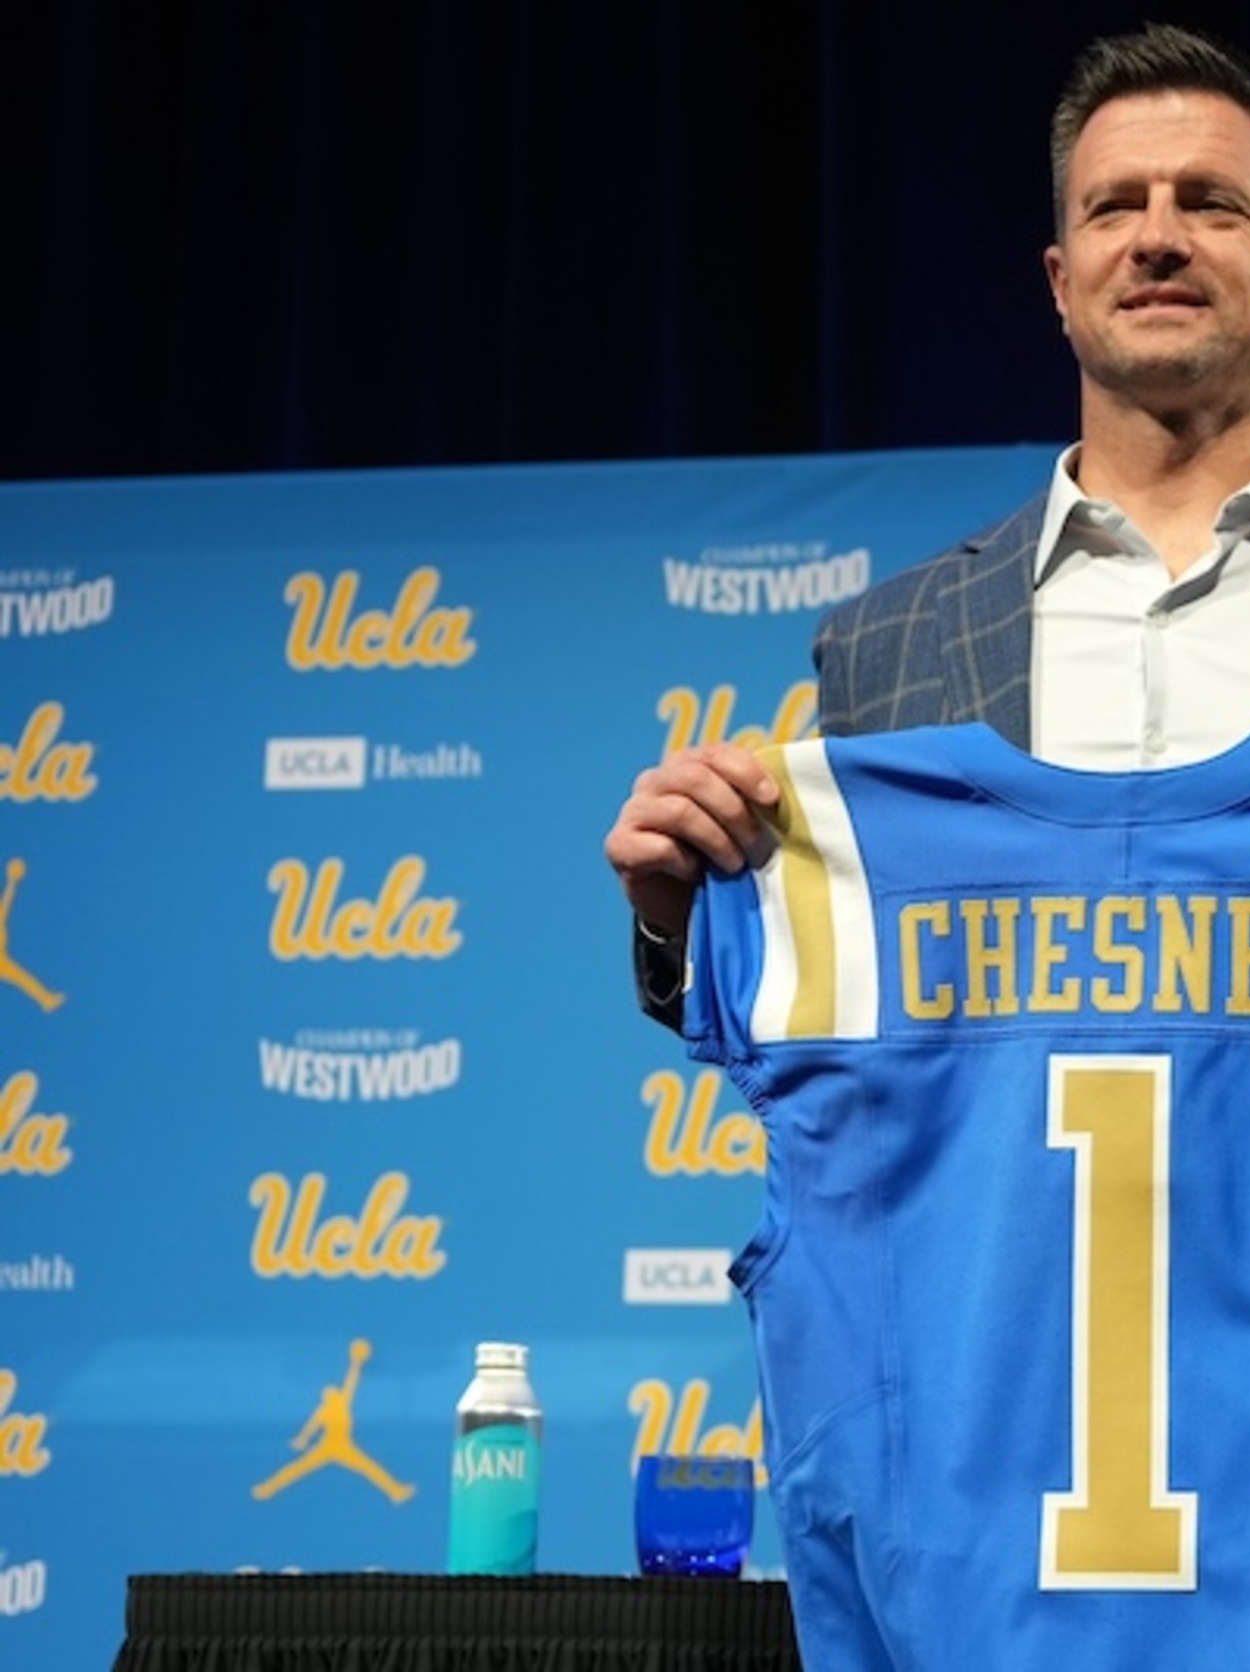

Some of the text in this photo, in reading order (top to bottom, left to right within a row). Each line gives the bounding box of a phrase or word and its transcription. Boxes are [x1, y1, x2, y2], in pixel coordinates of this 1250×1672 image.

[284, 566, 477, 672] Ucla
[663, 547, 871, 615] WESTWOOD
[278, 742, 483, 780] UCLA Health
[267, 854, 463, 961] Ucla
[258, 1037, 461, 1102] WESTWOOD
[249, 1171, 447, 1280] Ucla
[638, 1261, 717, 1290] UCLA
[1039, 1054, 1198, 1592] 1
